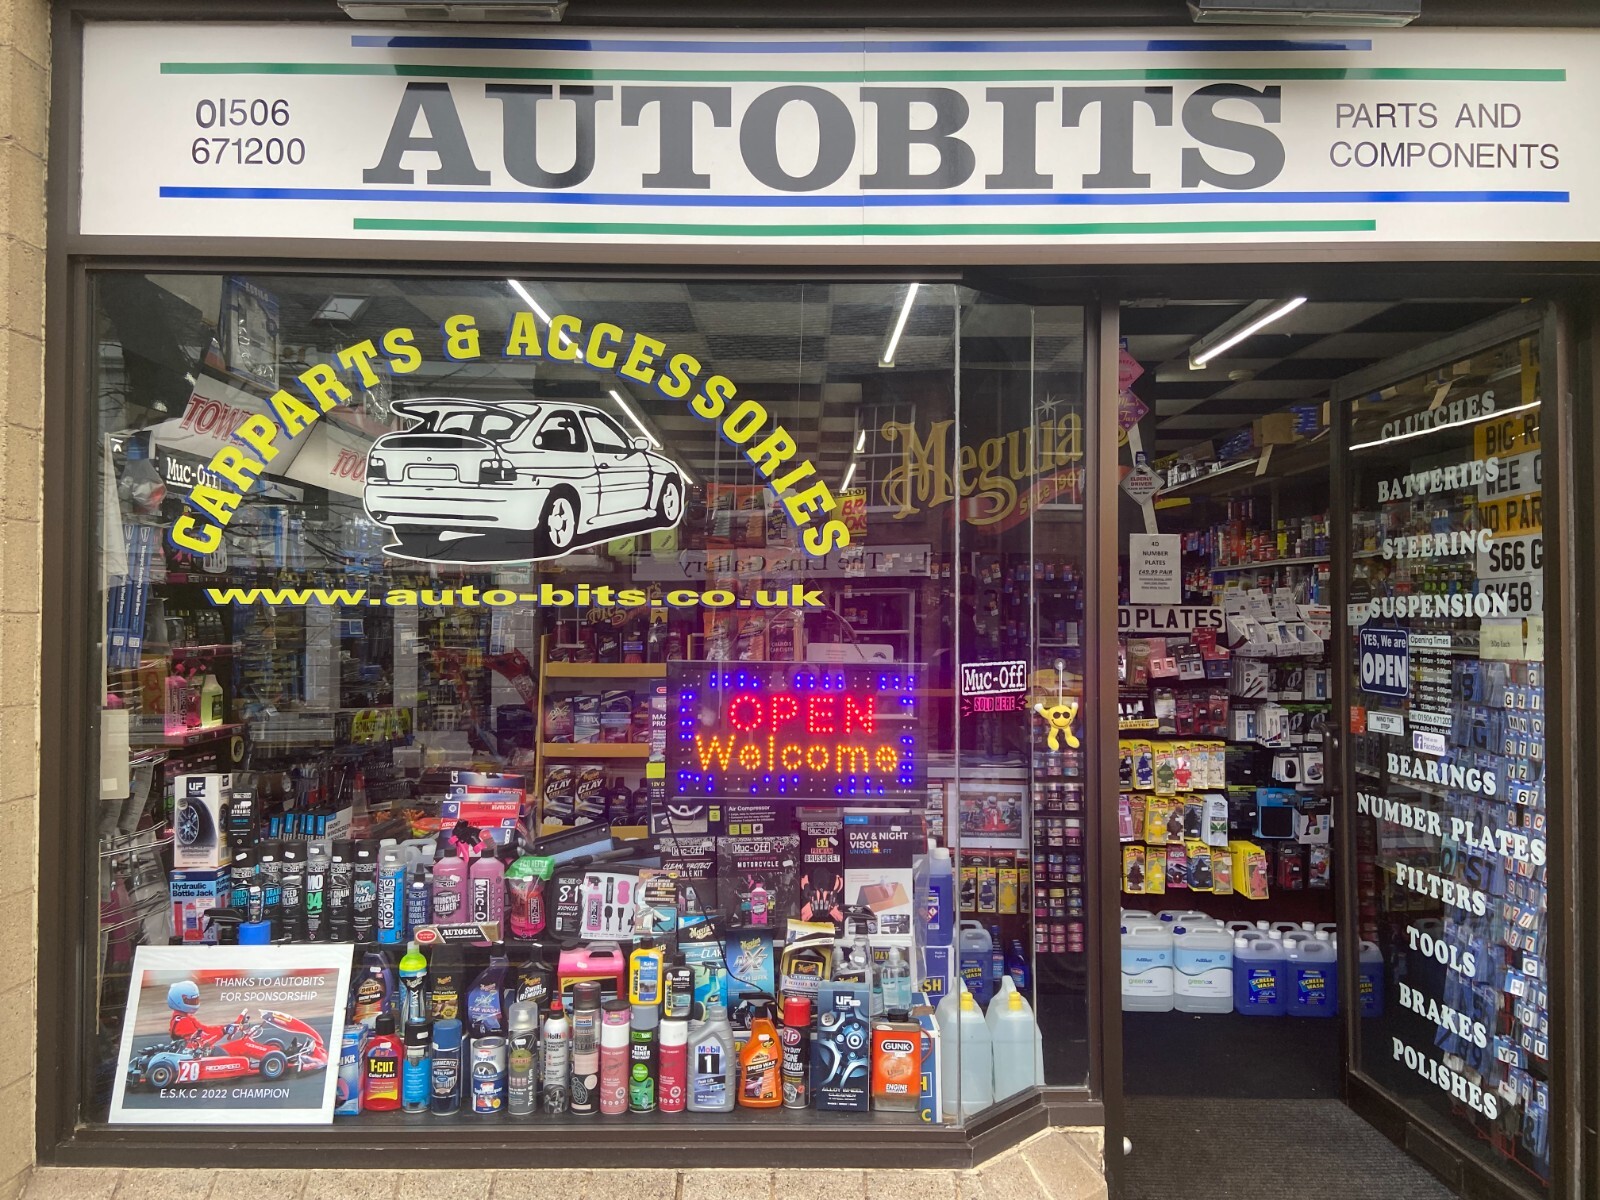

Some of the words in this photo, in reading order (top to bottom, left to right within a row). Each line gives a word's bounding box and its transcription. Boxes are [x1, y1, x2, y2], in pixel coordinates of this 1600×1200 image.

[195, 99, 290, 128] 01506
[1336, 103, 1438, 129] PARTS
[1455, 103, 1522, 129] AND
[362, 82, 1285, 192] AUTOBITS
[191, 137, 306, 165] 671200
[1329, 142, 1560, 170] COMPONENTS
[1381, 390, 1495, 442] CLUTCHES
[440, 314, 481, 362] &
[503, 312, 850, 557] ACCESSORIES
[1485, 421, 1514, 455] BIG
[1378, 457, 1500, 502] BATTERIES
[1382, 528, 1494, 560] STEERING
[1489, 540, 1525, 572] S66
[203, 584, 827, 608] www.auto-bits.co.uk
[1370, 593, 1509, 618] SUSPENSION
[1135, 608, 1223, 628] PLATES
[1363, 634, 1379, 649] YES,
[1380, 634, 1392, 647] We
[1394, 638, 1406, 648] are
[1410, 636, 1433, 646] Opening
[1434, 636, 1449, 645] Times
[965, 665, 1025, 691] Muc-Off
[1362, 652, 1407, 688] OPEN
[730, 696, 874, 733] OPEN
[974, 697, 994, 711] SOLD
[995, 696, 1015, 711] HERE
[695, 735, 898, 773] Welcome
[1423, 742, 1443, 752] Facebook
[546, 779, 571, 794] CLAY
[578, 779, 603, 794] CLAY
[1387, 753, 1497, 795] BEARINGS
[1519, 792, 1526, 802] 6
[850, 832, 869, 840] DAY
[879, 832, 908, 840] NIGHT
[1357, 792, 1443, 837] NUMBER
[1451, 816, 1547, 866] PLATES
[734, 843, 769, 852] Muc-Off
[172, 883, 206, 892] Hydraulic
[1395, 862, 1486, 916] FILTERS
[384, 879, 395, 928] SILICON
[1406, 925, 1477, 978] TOOLS
[215, 977, 255, 987] THANKS
[258, 977, 271, 986] TO
[274, 976, 325, 986] AUTOBITS
[1252, 977, 1275, 985] SCREEN
[1302, 978, 1325, 986] SCREEN
[220, 992, 241, 1001] FOR
[244, 992, 317, 1001] SPONSORSHIP
[1398, 982, 1487, 1049] BRAKES
[783, 1029, 798, 1043] STP
[179, 1063, 199, 1082] 20
[370, 1059, 394, 1073] T-CUT
[704, 1055, 712, 1073] 1
[1392, 1036, 1498, 1119] POLISHES
[160, 1089, 197, 1099] E.S.K.C
[201, 1089, 227, 1099] 2022
[232, 1089, 289, 1098] CHAMPION
[922, 1108, 931, 1122] C
